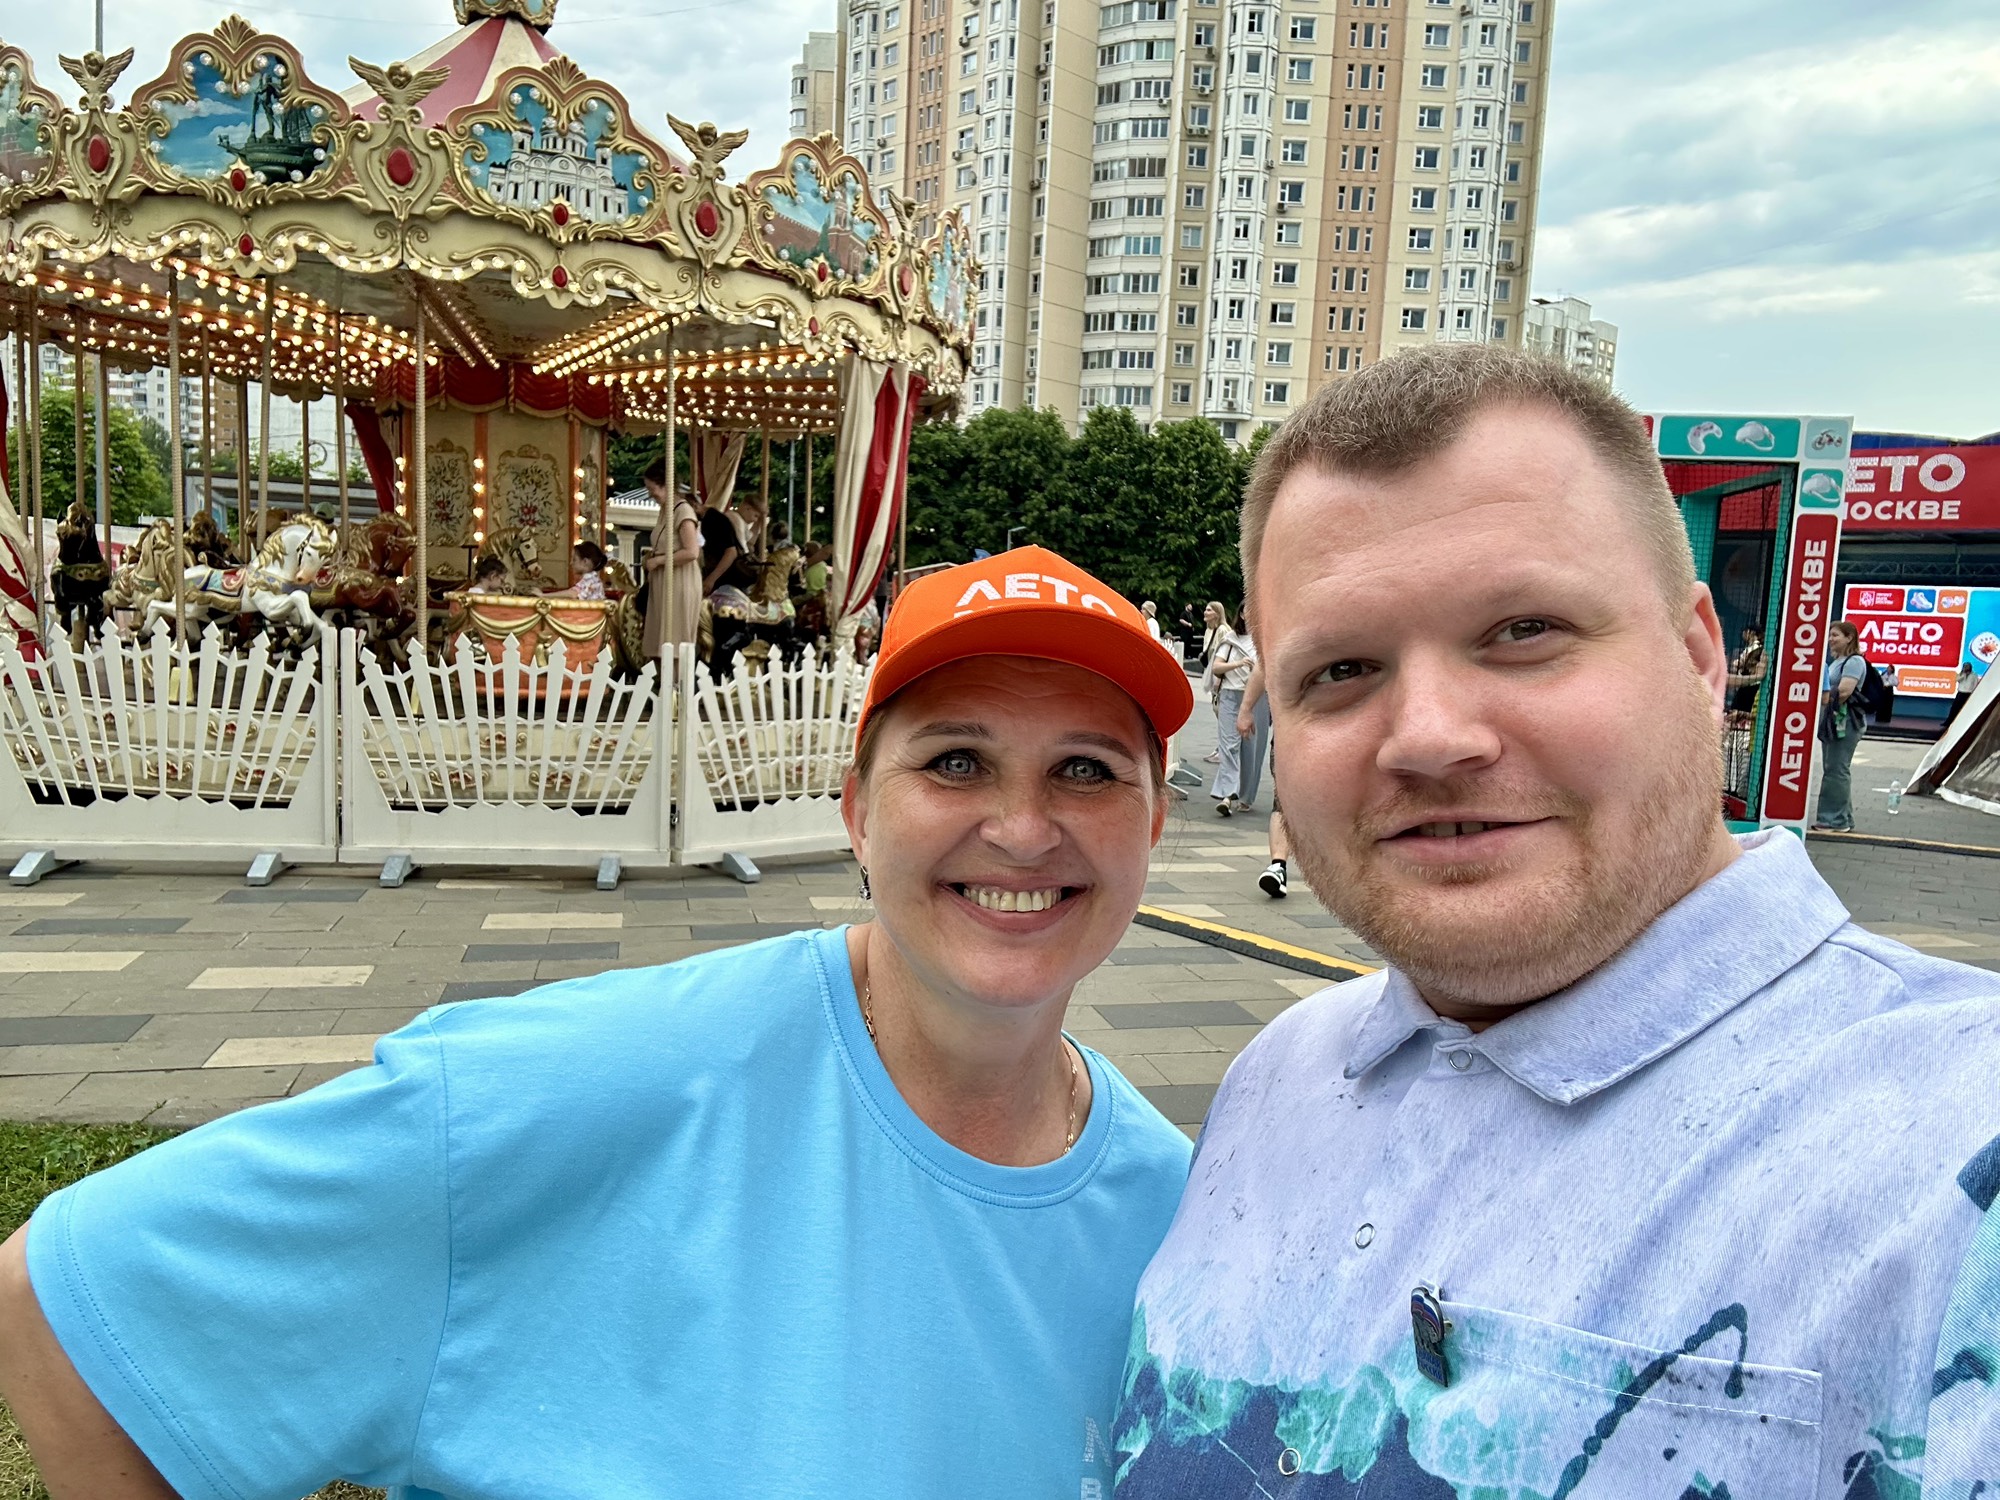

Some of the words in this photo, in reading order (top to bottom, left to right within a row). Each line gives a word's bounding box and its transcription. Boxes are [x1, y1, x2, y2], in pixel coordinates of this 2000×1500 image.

[1846, 453, 1966, 493] ЕТО
[1792, 539, 1827, 672] МОСКВЕ
[1859, 620, 1944, 643] ЛЕТО
[1872, 642, 1942, 656] МОСКВЕ
[1789, 681, 1810, 703] В
[1779, 711, 1808, 792] ЛЕТО
